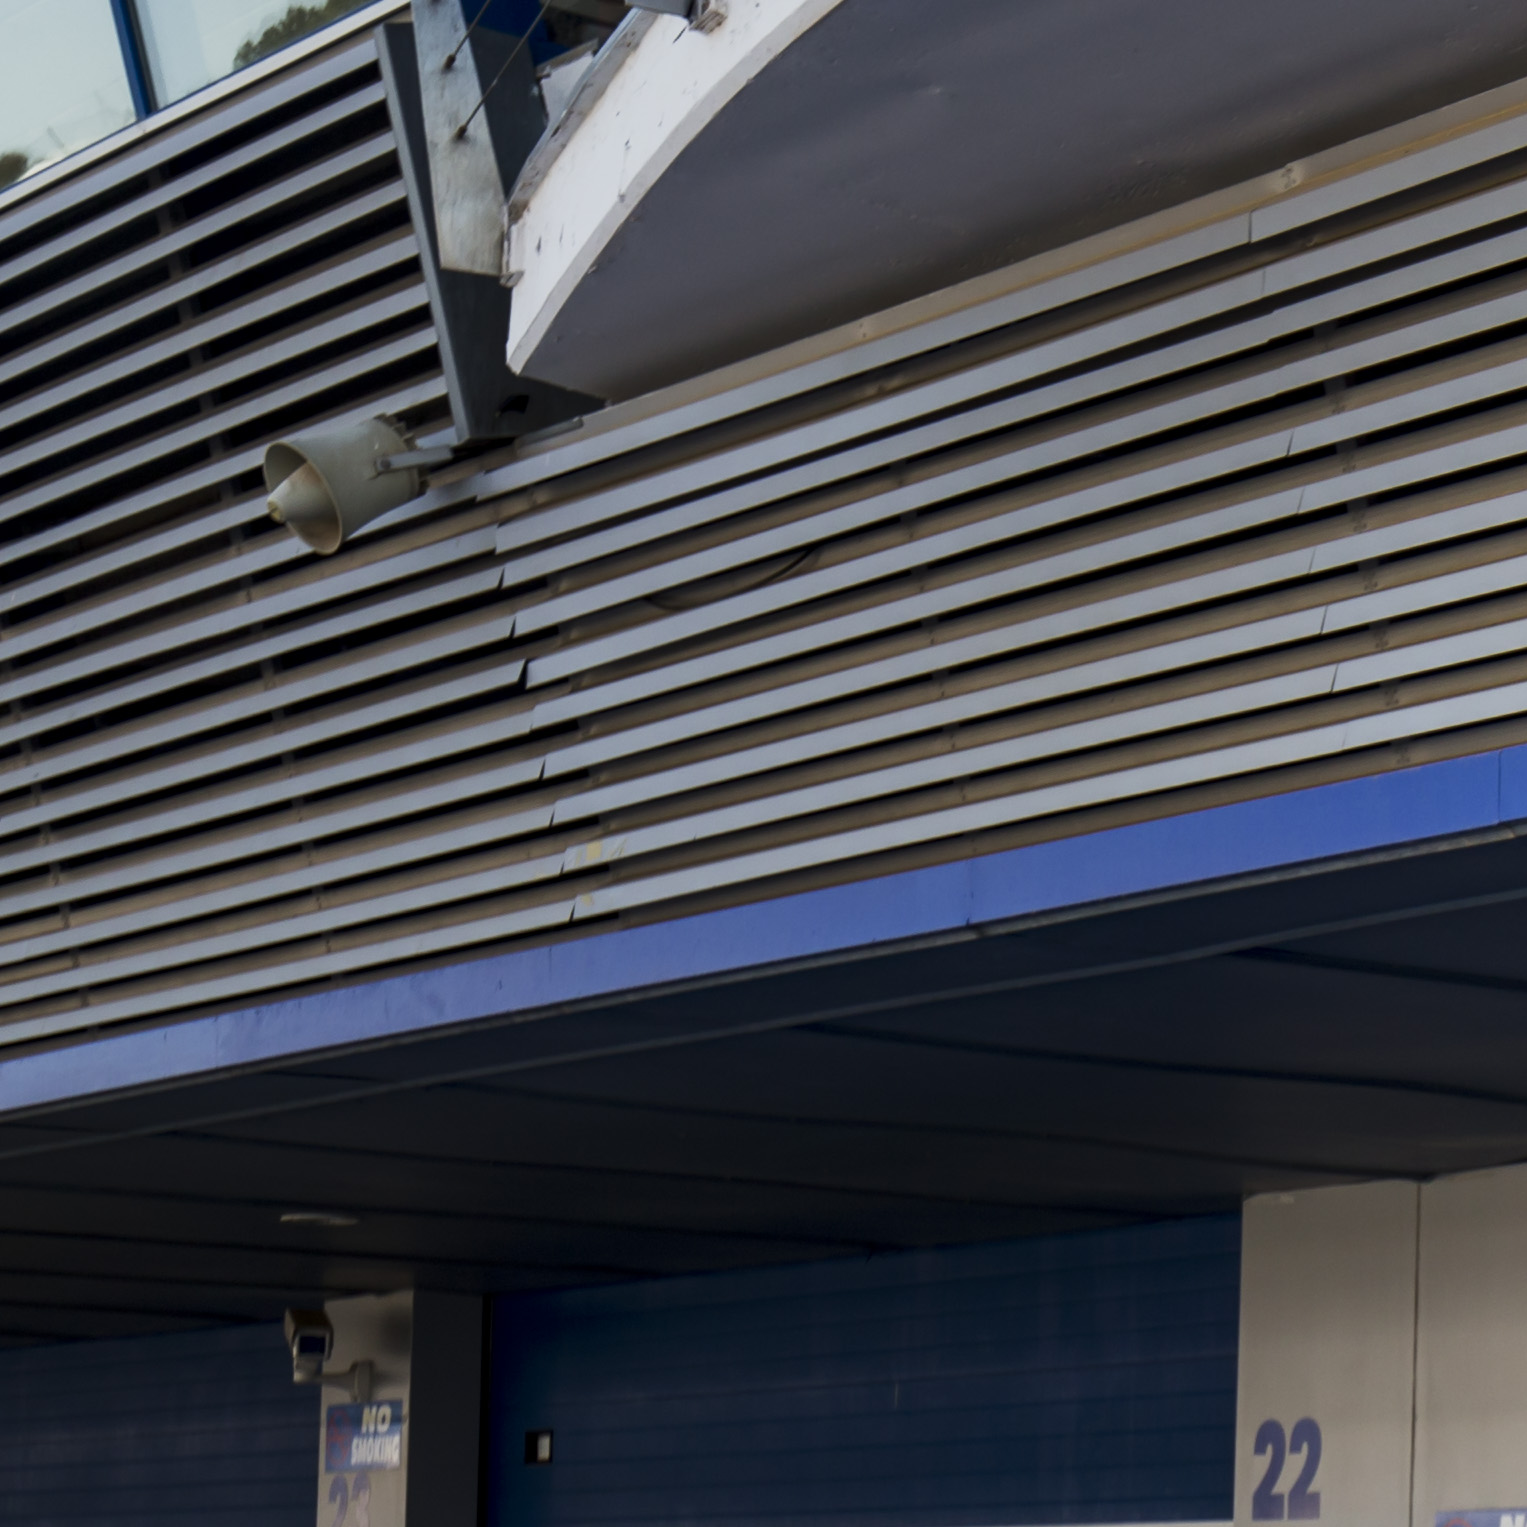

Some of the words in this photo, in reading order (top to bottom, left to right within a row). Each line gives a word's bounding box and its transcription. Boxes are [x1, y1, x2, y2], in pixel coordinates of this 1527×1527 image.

[361, 1404, 392, 1434] NO
[351, 1430, 400, 1467] SMOKING
[1251, 1417, 1323, 1521] 22
